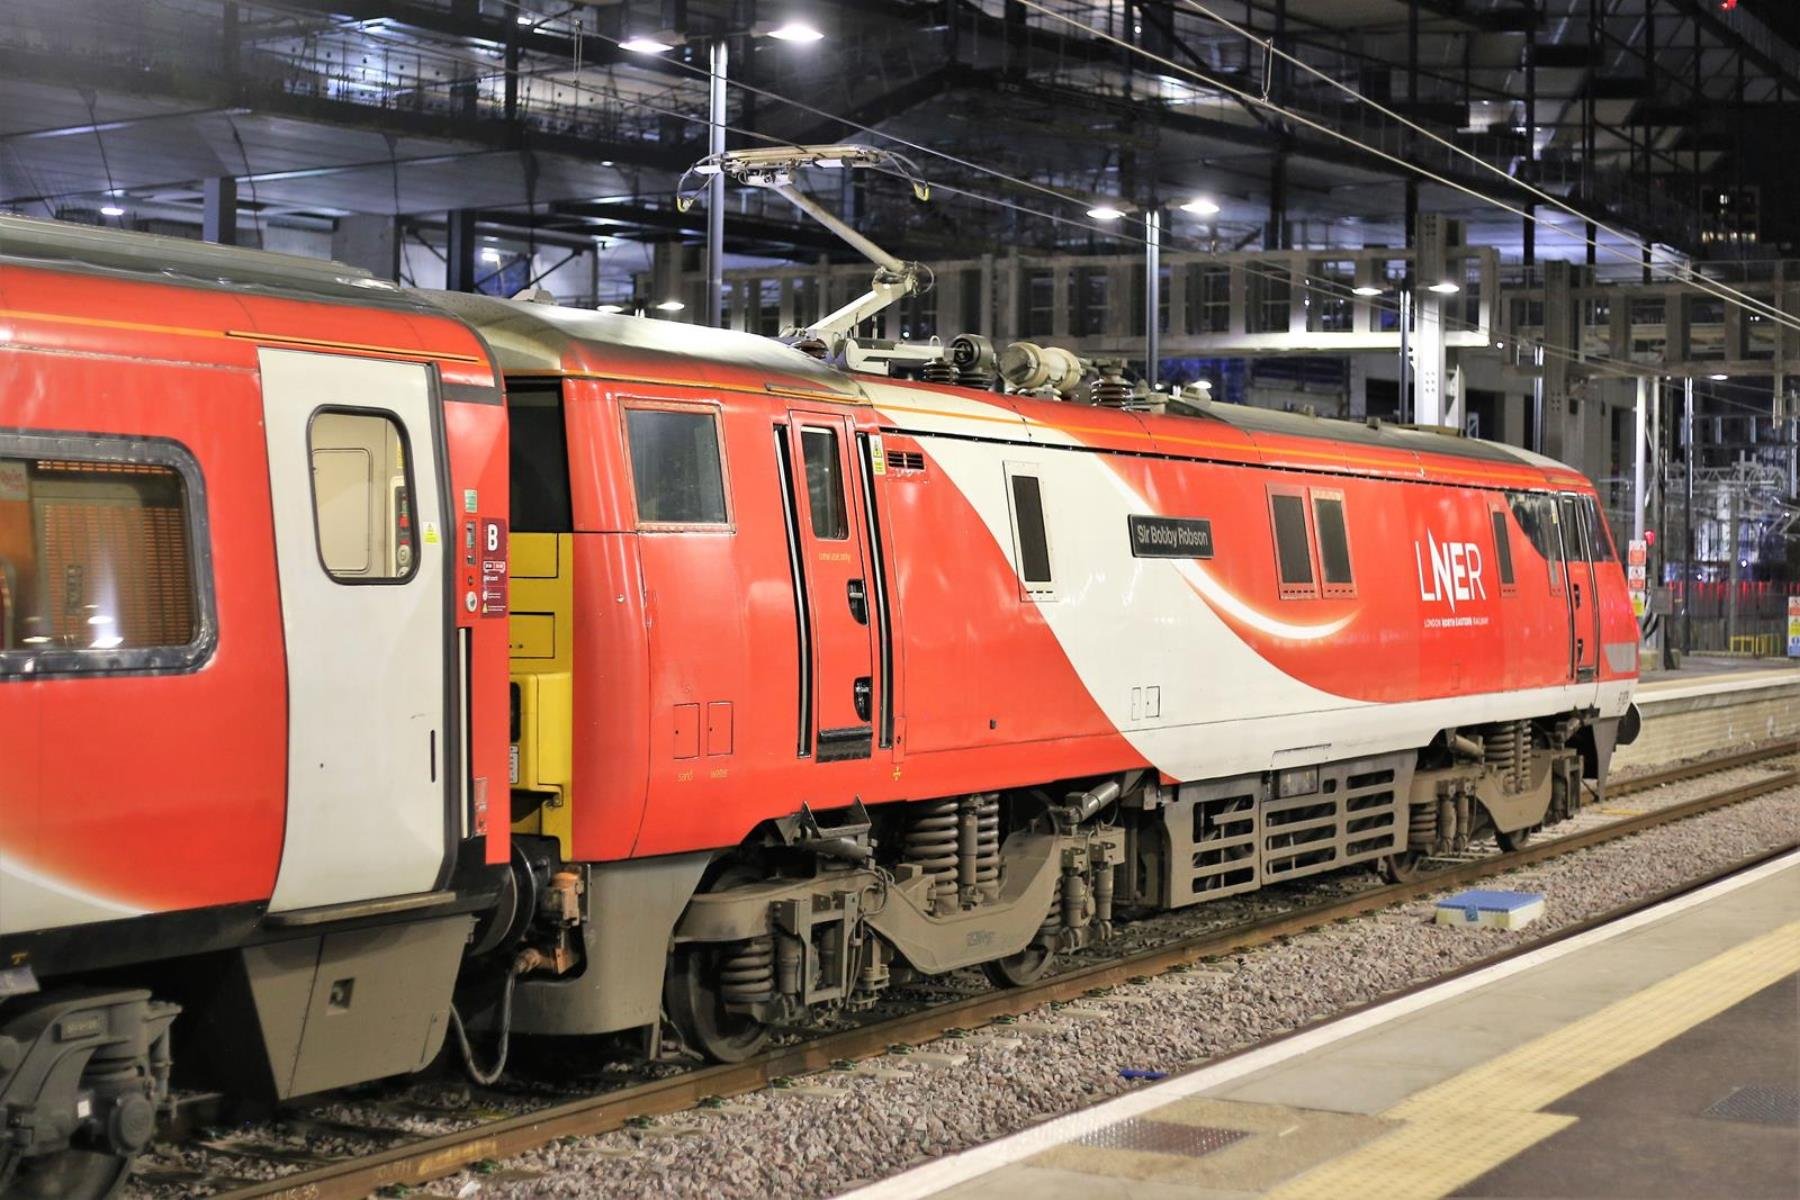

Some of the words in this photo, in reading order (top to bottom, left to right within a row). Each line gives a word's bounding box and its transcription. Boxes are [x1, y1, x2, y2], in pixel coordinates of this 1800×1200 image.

[487, 523, 498, 551] B
[1137, 525, 1150, 543] Sir
[1150, 526, 1178, 548] Bobby
[1178, 527, 1208, 546] Robson
[1414, 527, 1487, 614] LNER
